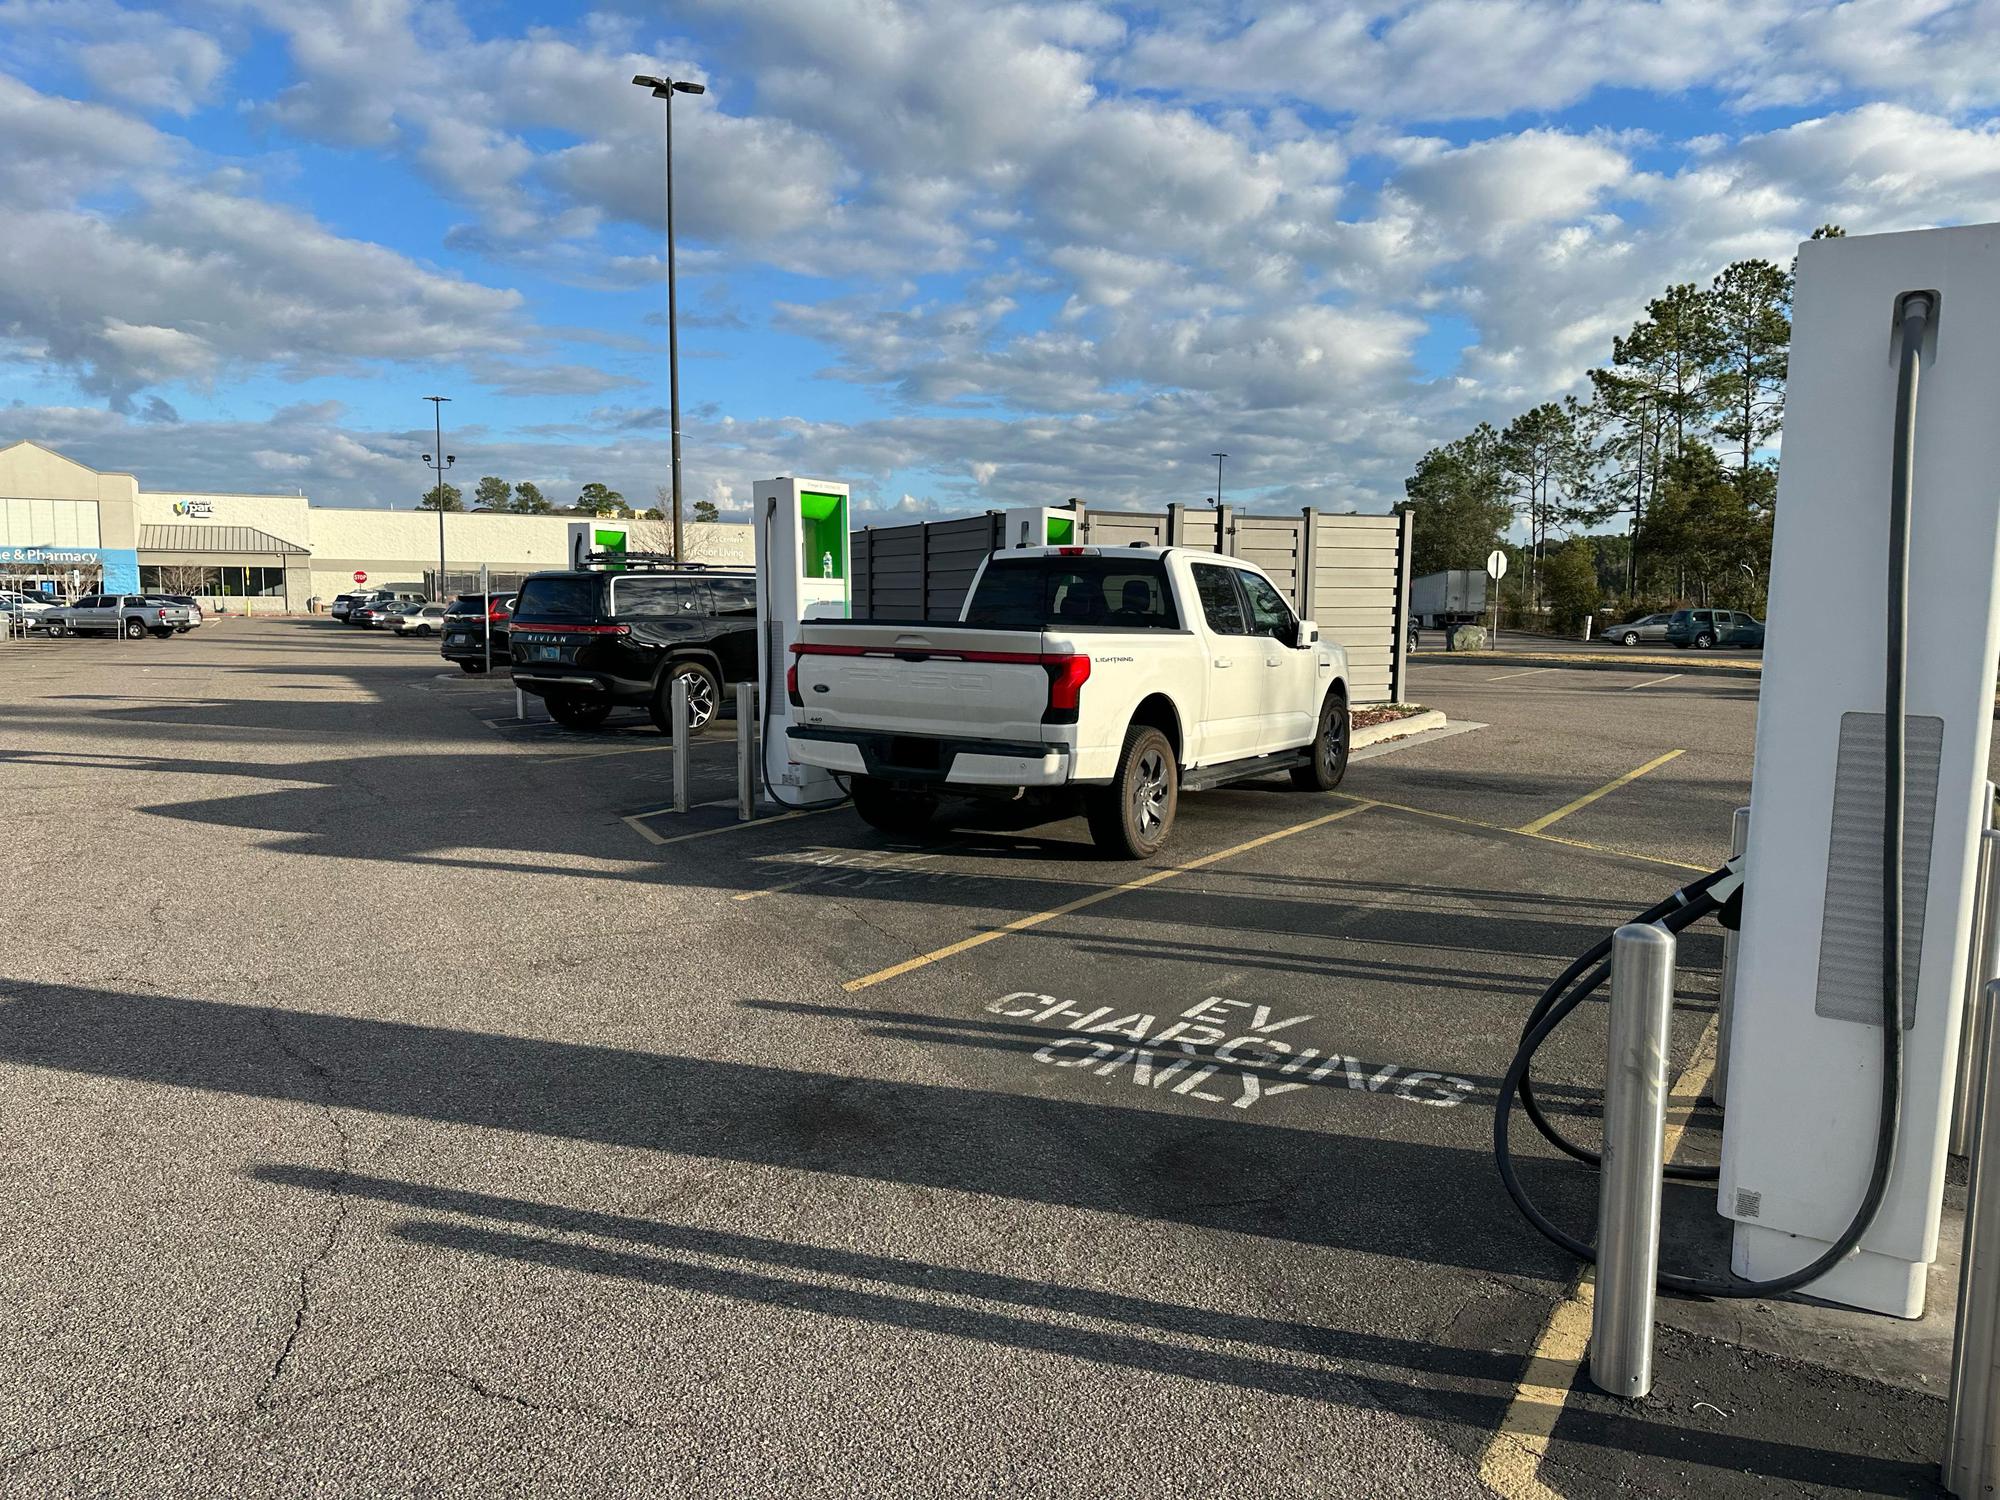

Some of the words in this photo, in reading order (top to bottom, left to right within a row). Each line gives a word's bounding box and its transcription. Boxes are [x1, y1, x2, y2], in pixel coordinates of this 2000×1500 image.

[14, 549, 24, 560] &
[27, 549, 97, 564] Pharmacy
[719, 547, 744, 560] Living
[527, 634, 567, 643] RIVIAN
[1180, 996, 1317, 1034] EV
[984, 991, 1476, 1108] CHARGING
[1032, 1036, 1312, 1109] ONLY
